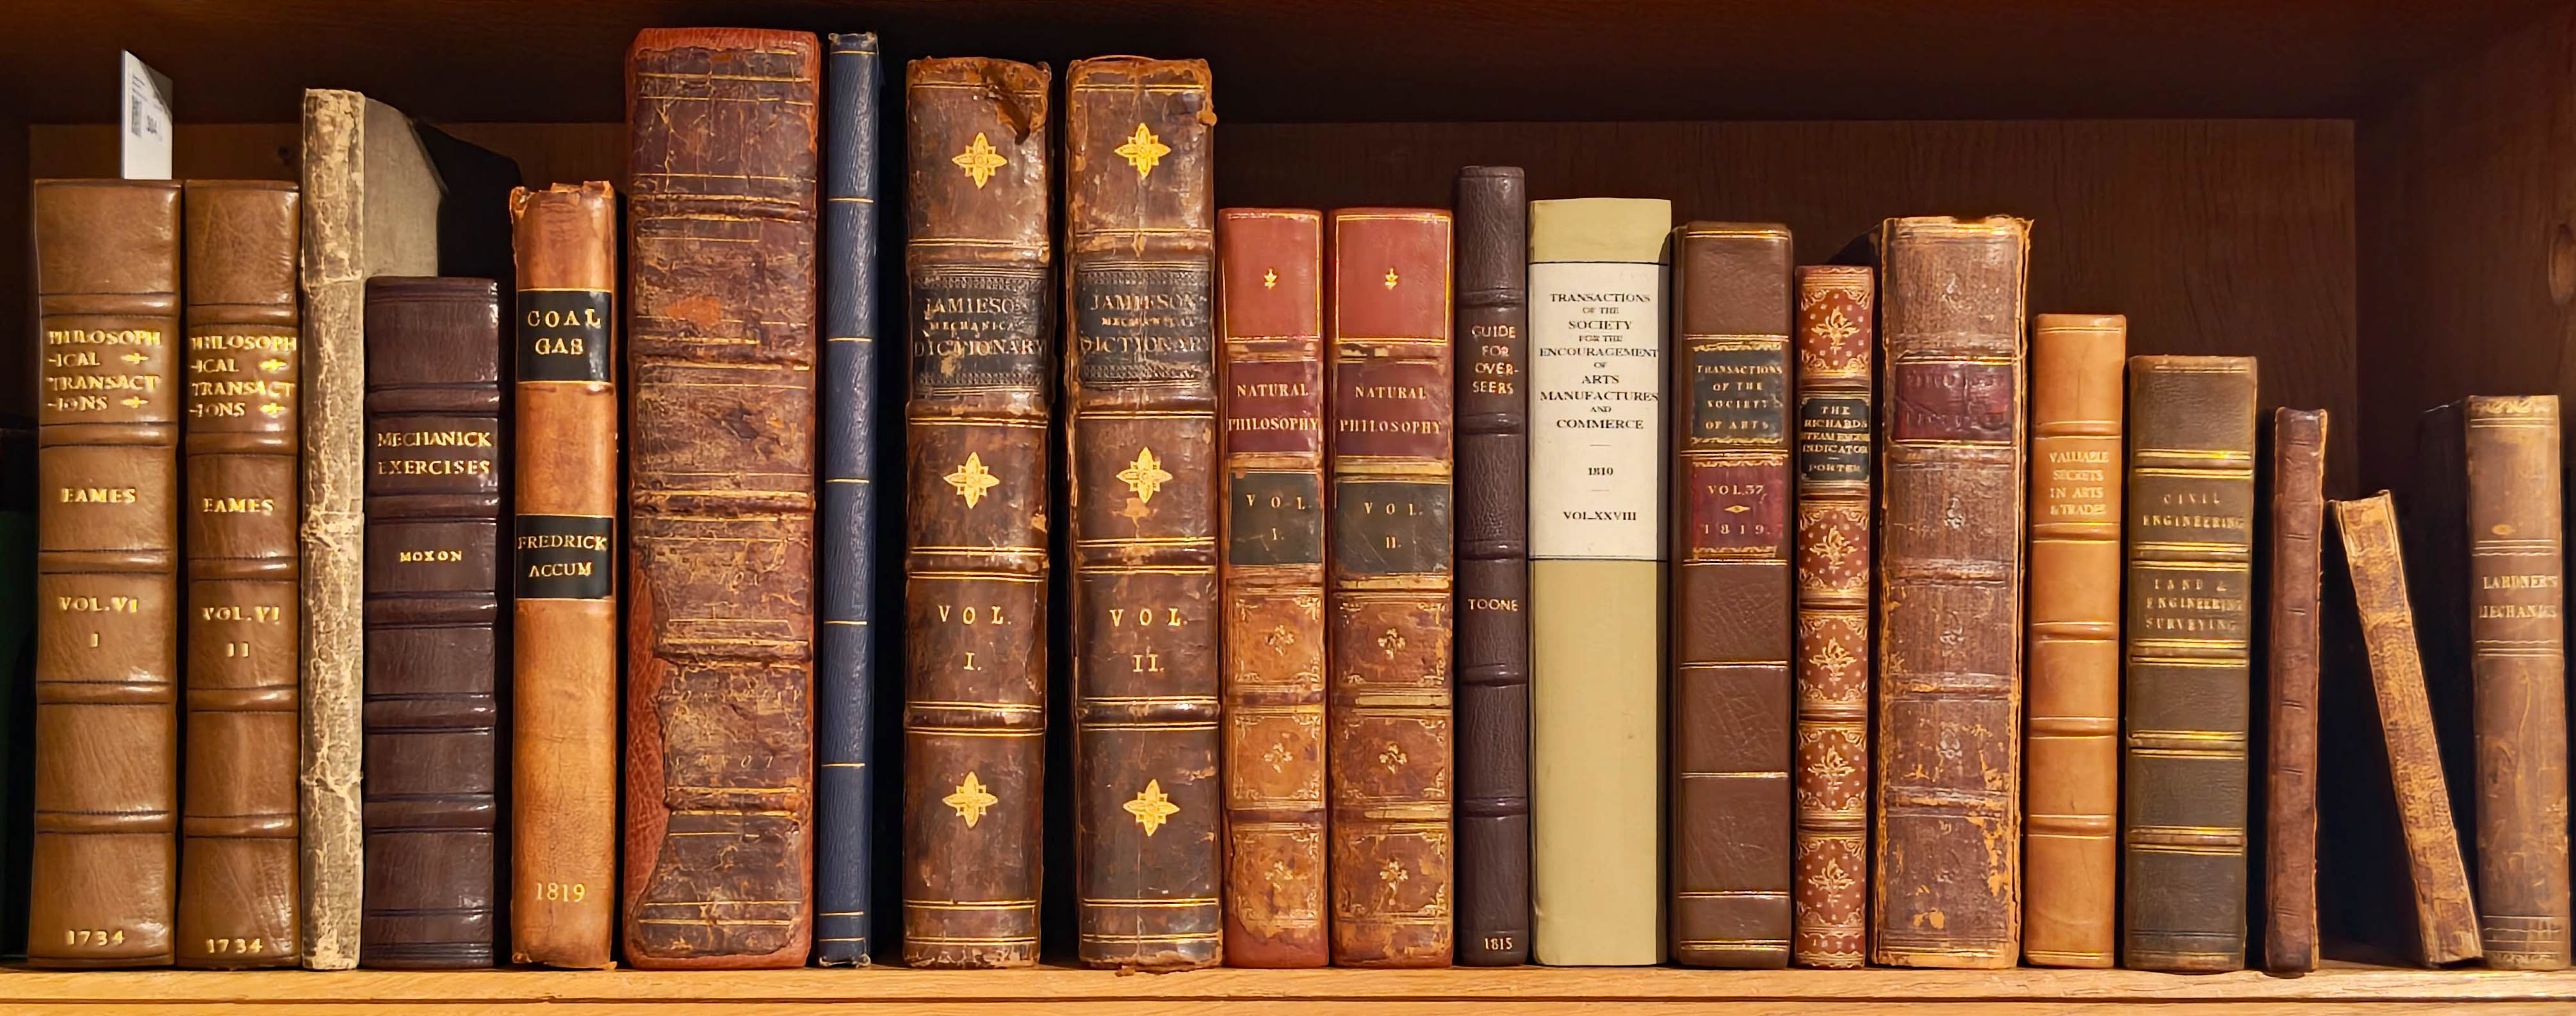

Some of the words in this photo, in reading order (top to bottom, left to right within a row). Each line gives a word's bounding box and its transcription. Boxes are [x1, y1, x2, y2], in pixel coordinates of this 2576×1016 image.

[1549, 293, 1651, 302] TRANSACTIONS
[527, 308, 601, 329] COAL
[1569, 320, 1633, 330] SOCIETY
[49, 329, 161, 345] PHILOSOPH
[1471, 325, 1516, 339] GUIDE
[535, 338, 584, 355] GAS
[1481, 345, 1510, 357] FOR
[1540, 347, 1659, 357] ENCOURAGEMENT
[1475, 362, 1520, 375] OVER-
[1696, 365, 1782, 375] TRANSACTIONS
[47, 375, 160, 391] TRANSACT
[1582, 375, 1619, 384] ARTS
[1713, 382, 1729, 391] OF
[1736, 382, 1763, 391] THE
[192, 381, 295, 397] TRANSACT
[1237, 384, 1308, 397] NATURAL
[1355, 386, 1426, 400] NATURAL
[1472, 381, 1514, 395] SEERS
[1540, 391, 1659, 402] MANUFACTURES
[1821, 406, 1851, 415] THE
[1228, 417, 1319, 431] PHILOSOPHY
[1339, 420, 1442, 435] PHILOSOPHY
[1556, 419, 1644, 430] COMMERCE
[1705, 421, 1722, 430] OF
[377, 431, 493, 448] MECHANICK
[377, 460, 491, 475] EXERCISES
[1588, 467, 1614, 476] 1810
[60, 488, 138, 504] EAMES
[2050, 487, 2067, 499] IN
[203, 497, 275, 515] EAMES
[518, 535, 608, 552] FREDRICK
[400, 551, 462, 562] MOXON
[528, 562, 592, 578] ACCUM
[1468, 599, 1519, 612] TOONE
[938, 605, 1012, 626] VOL.
[1109, 607, 1188, 627] VOL.
[536, 882, 586, 902] 1819
[67, 930, 125, 946] 1734
[1485, 937, 1513, 950] 1815
[206, 938, 263, 954] 1734
